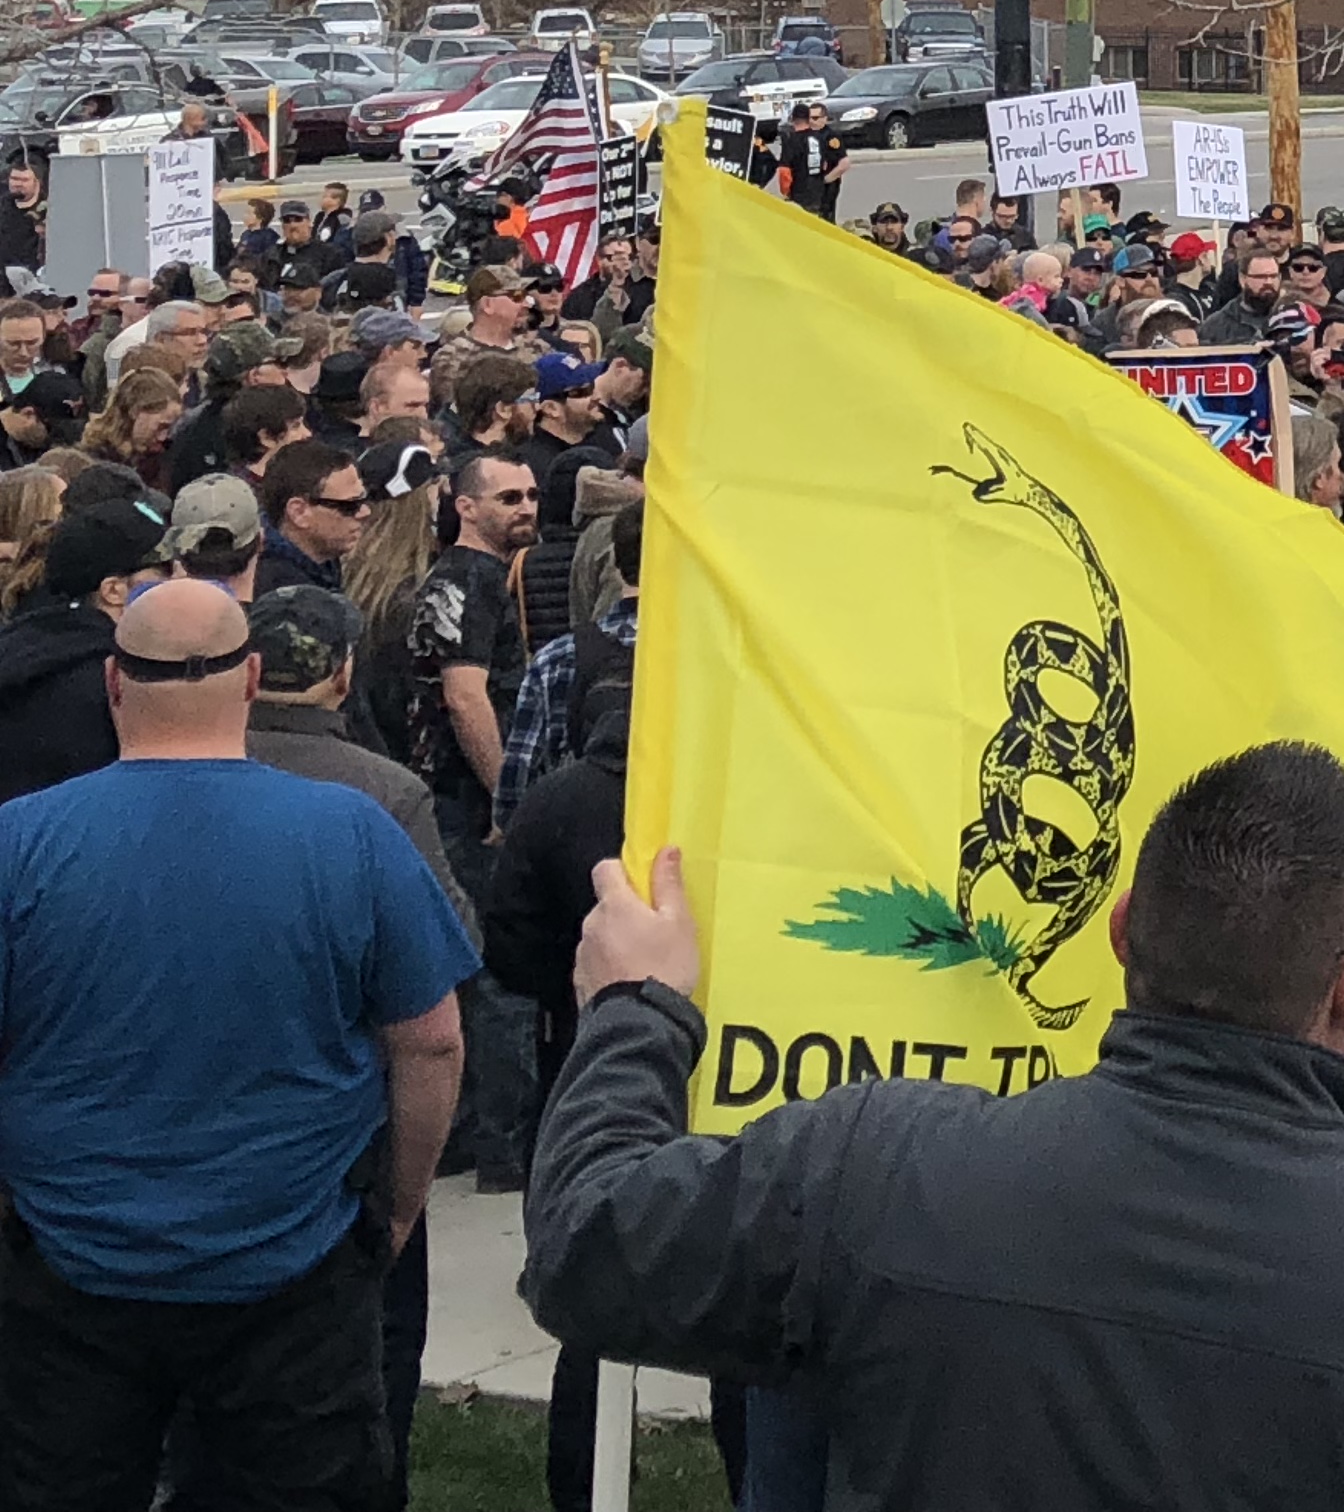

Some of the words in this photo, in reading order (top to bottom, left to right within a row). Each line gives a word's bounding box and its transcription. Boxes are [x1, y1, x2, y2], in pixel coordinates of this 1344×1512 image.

[999, 103, 1045, 130] This
[1041, 97, 1088, 126] Truth
[1088, 89, 1126, 117] Will
[705, 116, 744, 134] sault
[1094, 122, 1136, 148] Bans
[712, 138, 723, 151] a
[611, 162, 634, 181] NOT
[705, 157, 744, 178] vior,
[1014, 164, 1077, 191] Always
[1079, 149, 1138, 182] FAIL
[617, 184, 633, 200] for
[1190, 186, 1211, 214] The
[1212, 188, 1242, 220] People
